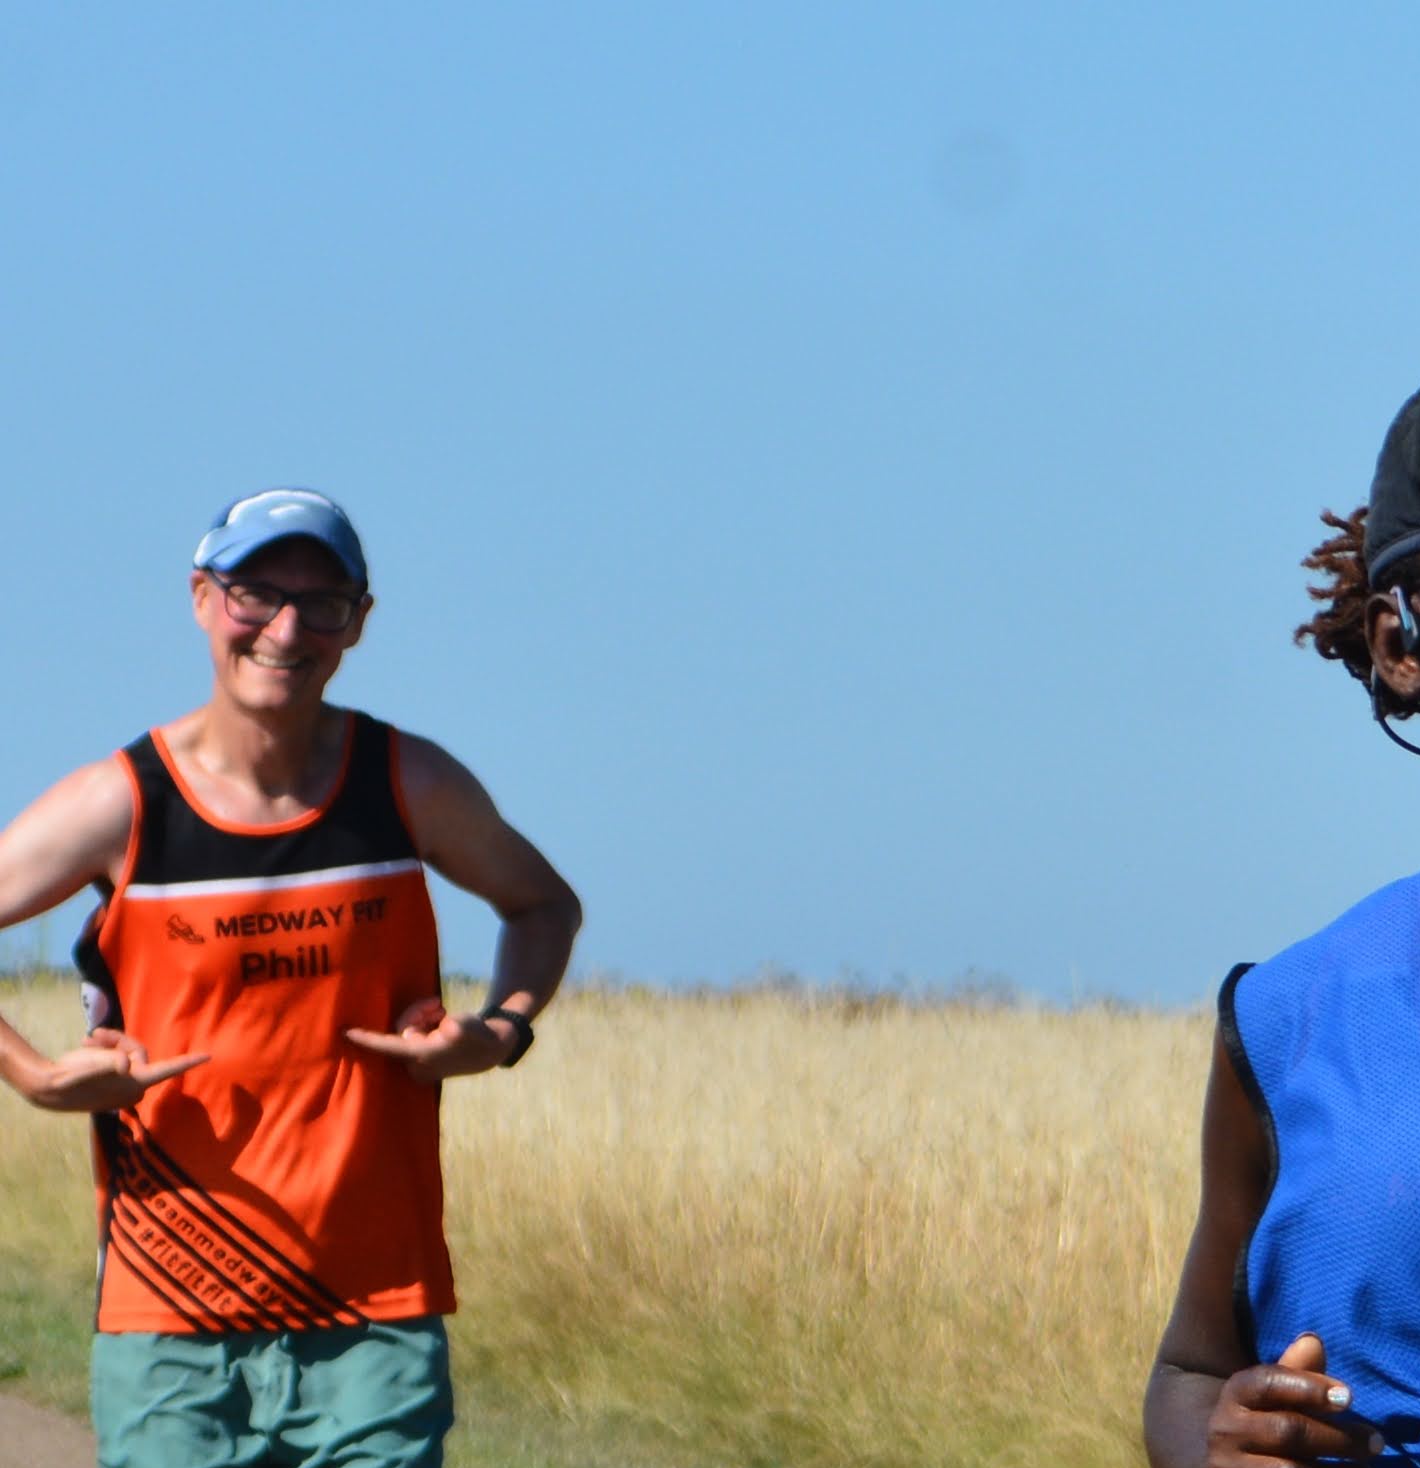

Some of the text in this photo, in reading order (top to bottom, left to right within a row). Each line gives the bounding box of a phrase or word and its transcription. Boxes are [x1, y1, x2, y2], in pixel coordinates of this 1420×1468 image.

[214, 897, 388, 938] MEDWAY FIT
[239, 944, 331, 980] Phill
